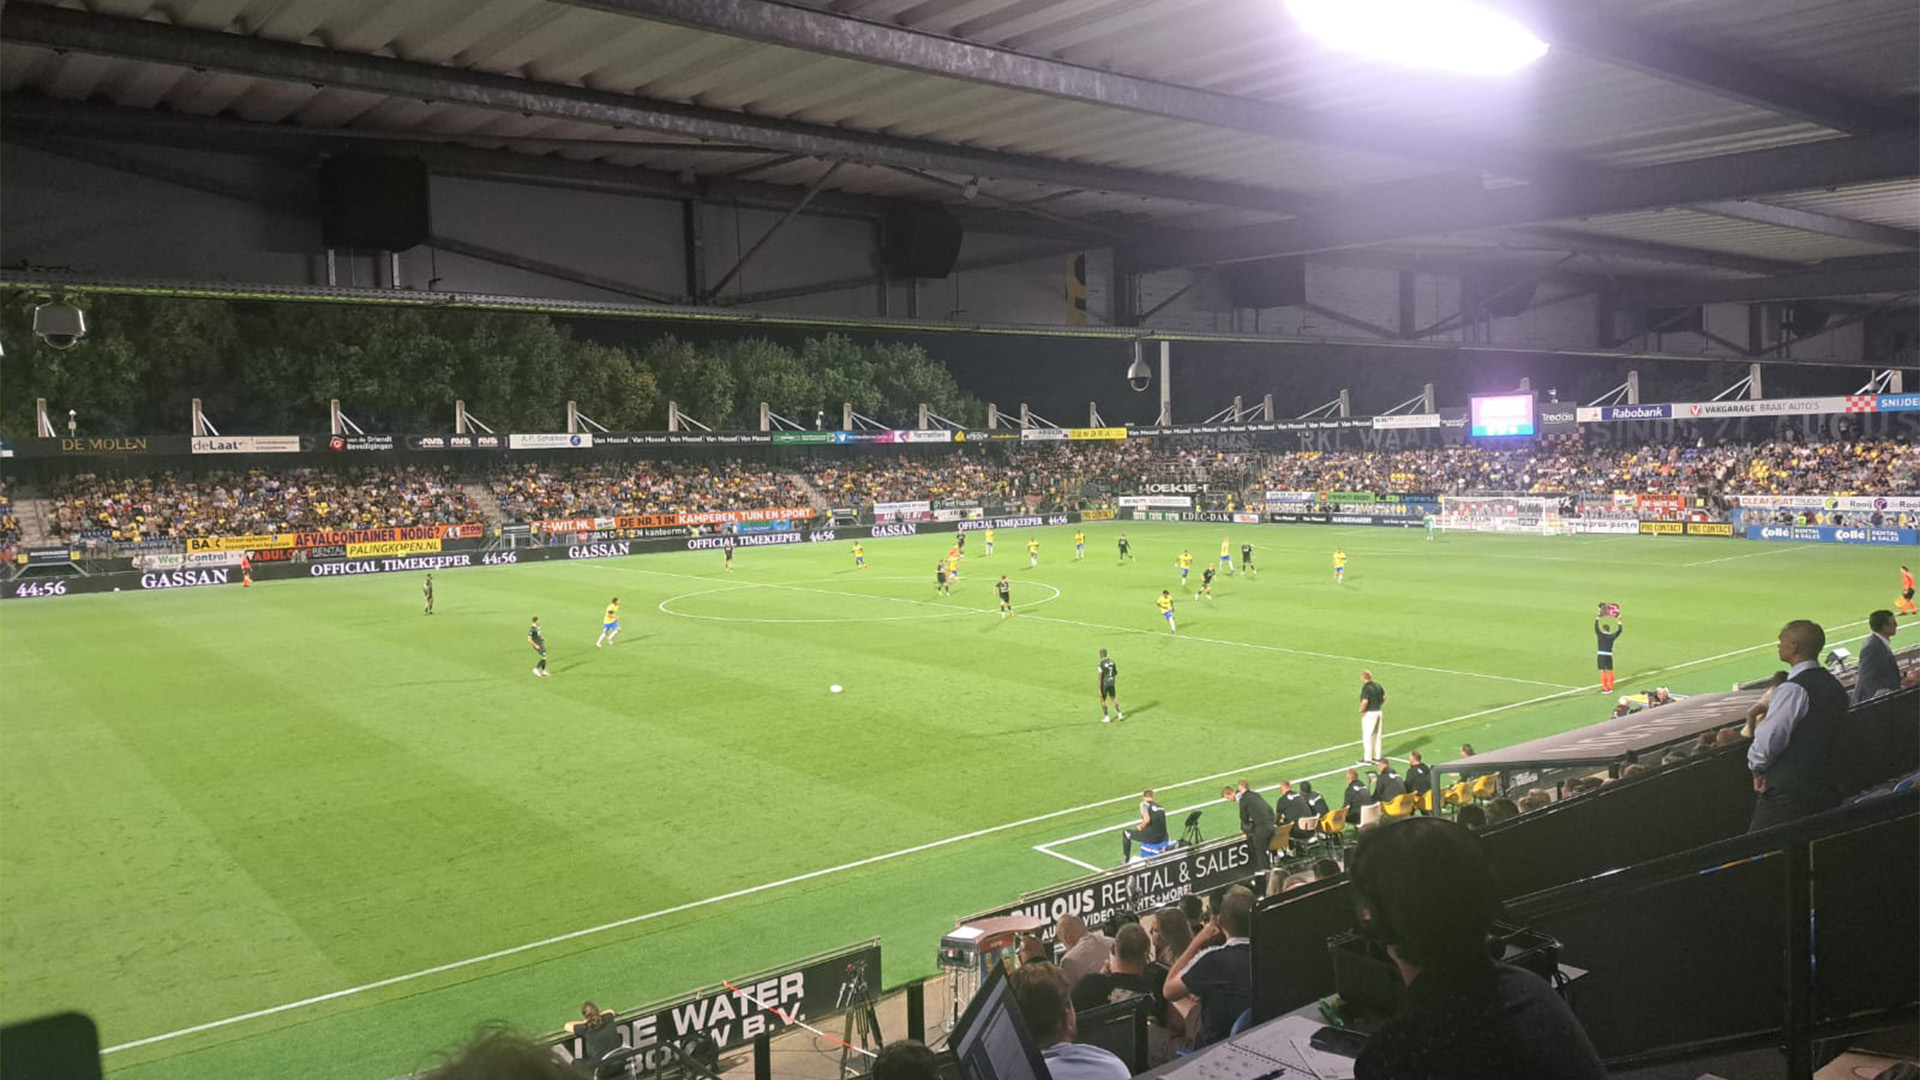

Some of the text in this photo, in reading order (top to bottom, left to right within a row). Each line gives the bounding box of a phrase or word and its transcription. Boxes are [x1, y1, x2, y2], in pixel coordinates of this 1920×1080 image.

[1612, 408, 1662, 418] Rabobank
[1704, 405, 1755, 413] VAKGARAGE
[1788, 402, 1820, 411] AUTO'S
[62, 438, 147, 450] DE MOLEN
[193, 440, 239, 450] deLaat
[620, 519, 634, 527] DE
[664, 516, 675, 524] IN
[741, 511, 763, 520] TUIN
[766, 510, 778, 518] EN
[781, 508, 811, 518] SPORT
[871, 524, 916, 537] GASSAN
[958, 515, 1068, 530] OFFICIAL TIMEKEEPER 44:56
[296, 526, 440, 547] AFVALCONTAINER NODIG?
[688, 531, 835, 550] OFFICIAL TIMEKEEPER 44:56
[349, 541, 439, 555] PALINGKOPEN.NL
[568, 541, 631, 559] GASSAN
[311, 552, 517, 577] OFFICIAL TIMEKEEPER 44:56
[141, 568, 229, 589] GASSAN
[16, 580, 67, 597] 44:56
[1011, 889, 1095, 925] ULOUS
[1179, 861, 1192, 882] &
[1196, 843, 1249, 878] SALES
[672, 971, 804, 1036] WATER
[742, 1002, 805, 1040] B.V.
